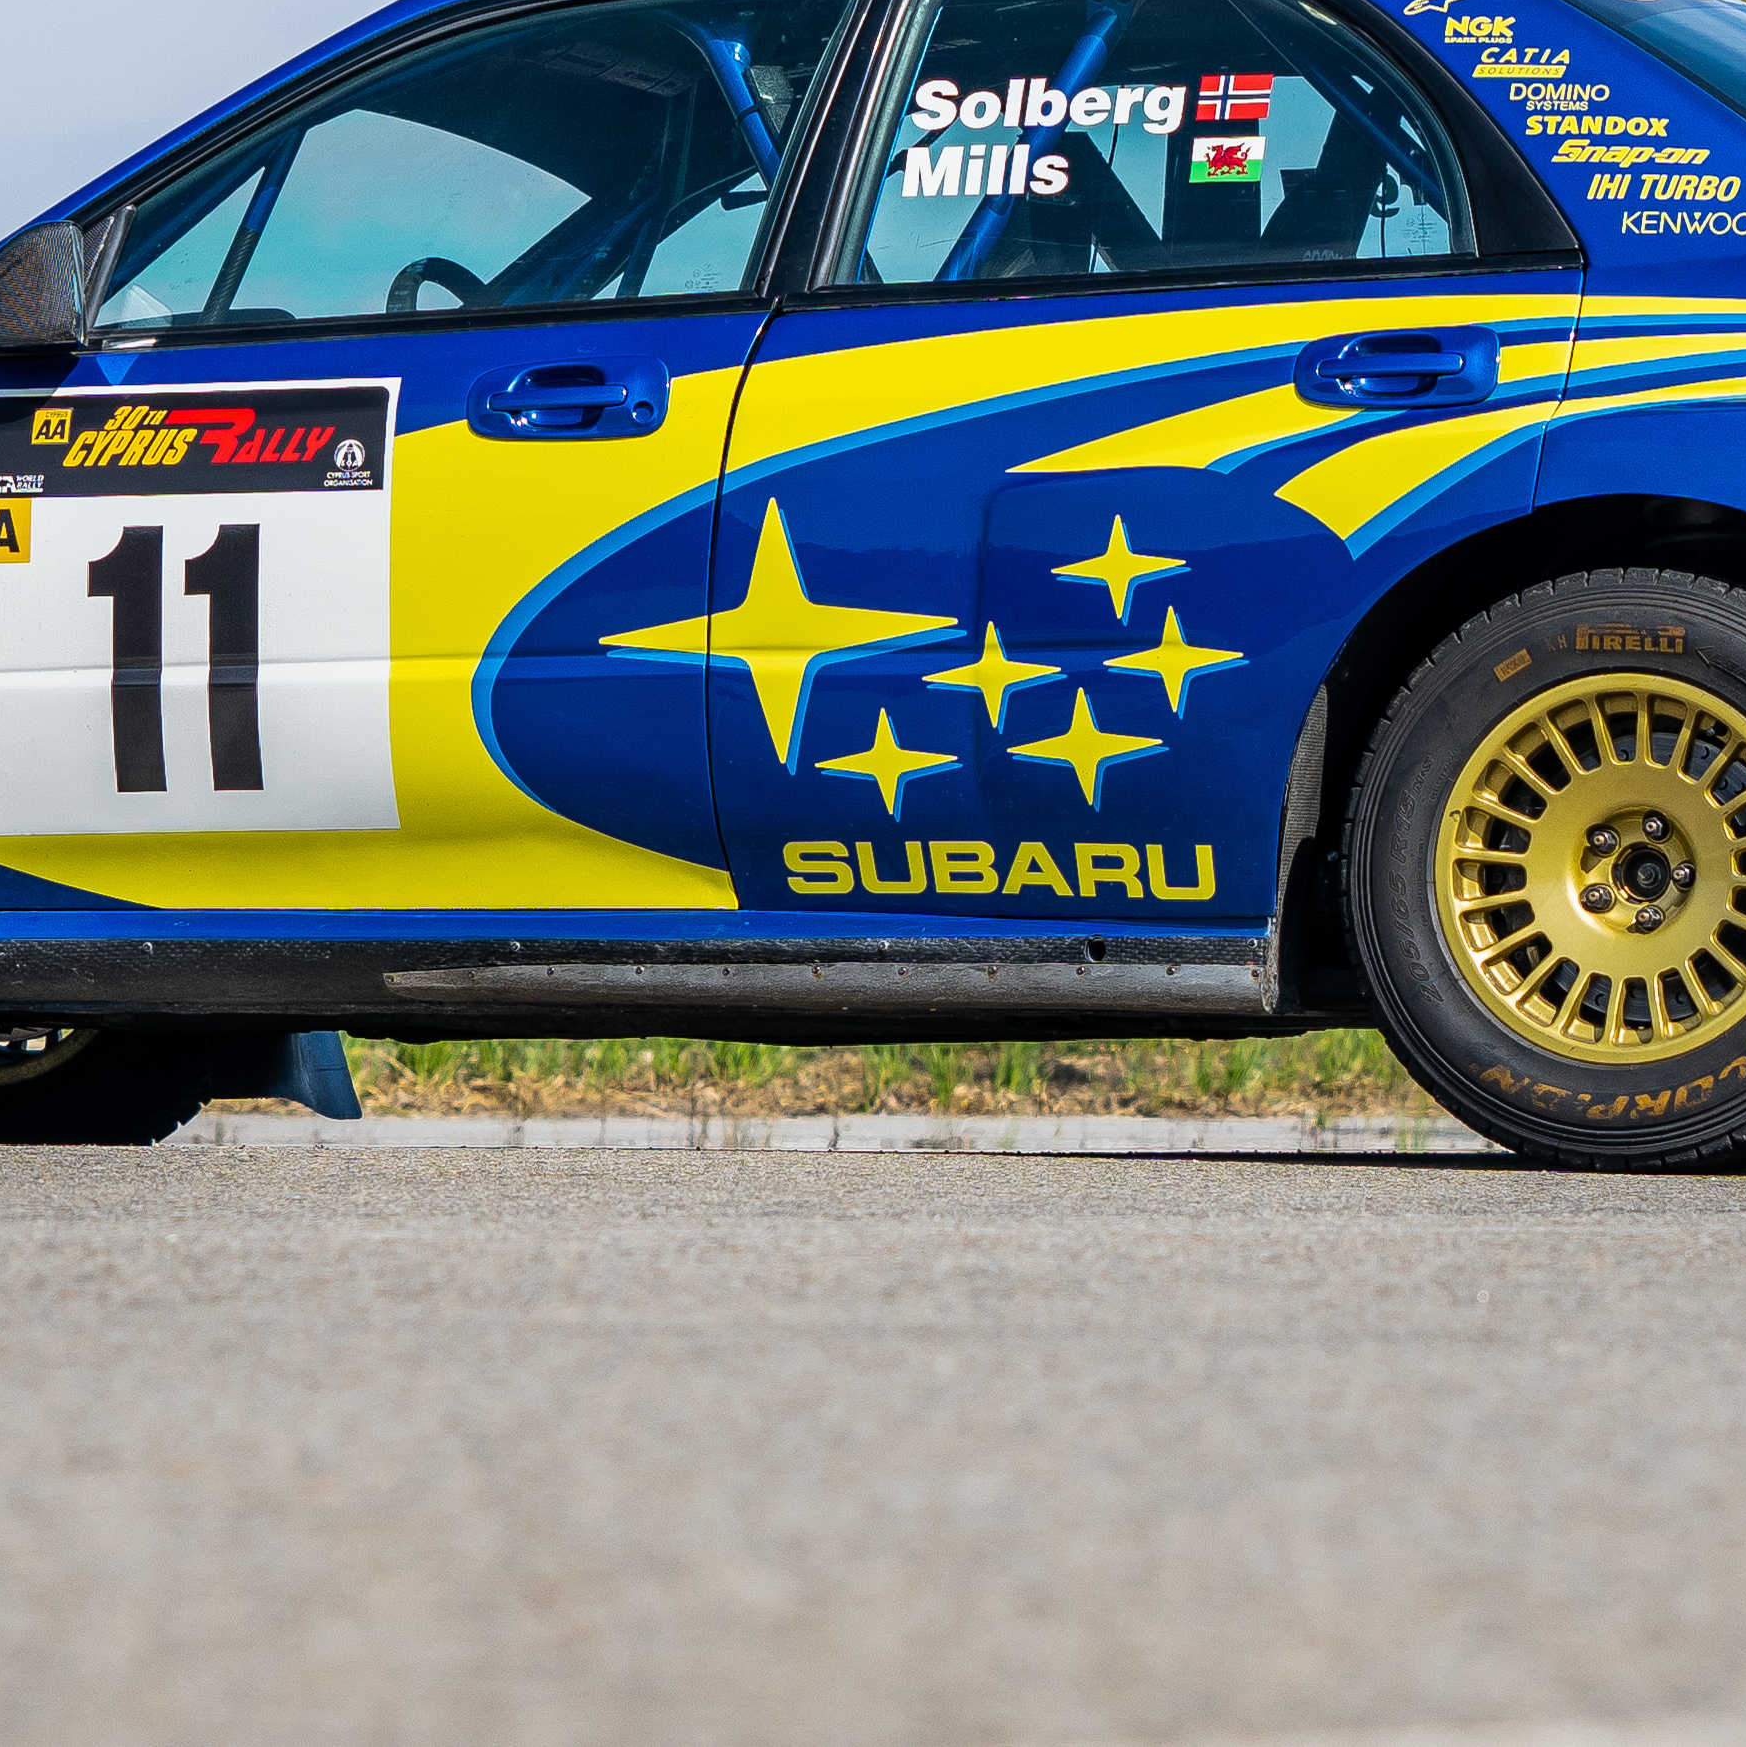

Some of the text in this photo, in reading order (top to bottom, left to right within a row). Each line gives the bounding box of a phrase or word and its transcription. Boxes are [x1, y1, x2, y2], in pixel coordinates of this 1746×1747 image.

[1444, 16, 1516, 37] NGK
[1480, 47, 1570, 64] CATIA
[1477, 66, 1561, 75] SOLUTIONS
[911, 77, 1187, 134] Solberg
[1509, 83, 1610, 101] DOMINO
[1526, 101, 1588, 111] SYSTEMS
[1525, 115, 1669, 137] STANDOX
[1551, 138, 1710, 168] Snap-on
[901, 143, 1069, 197] Mills
[1587, 174, 1741, 202] IHI TURBO
[34, 419, 67, 440] AA
[63, 428, 197, 467] CYPRUS
[1576, 624, 1686, 653] PIRELLI
[87, 524, 265, 792] 11
[782, 840, 1215, 900] SUBARU
